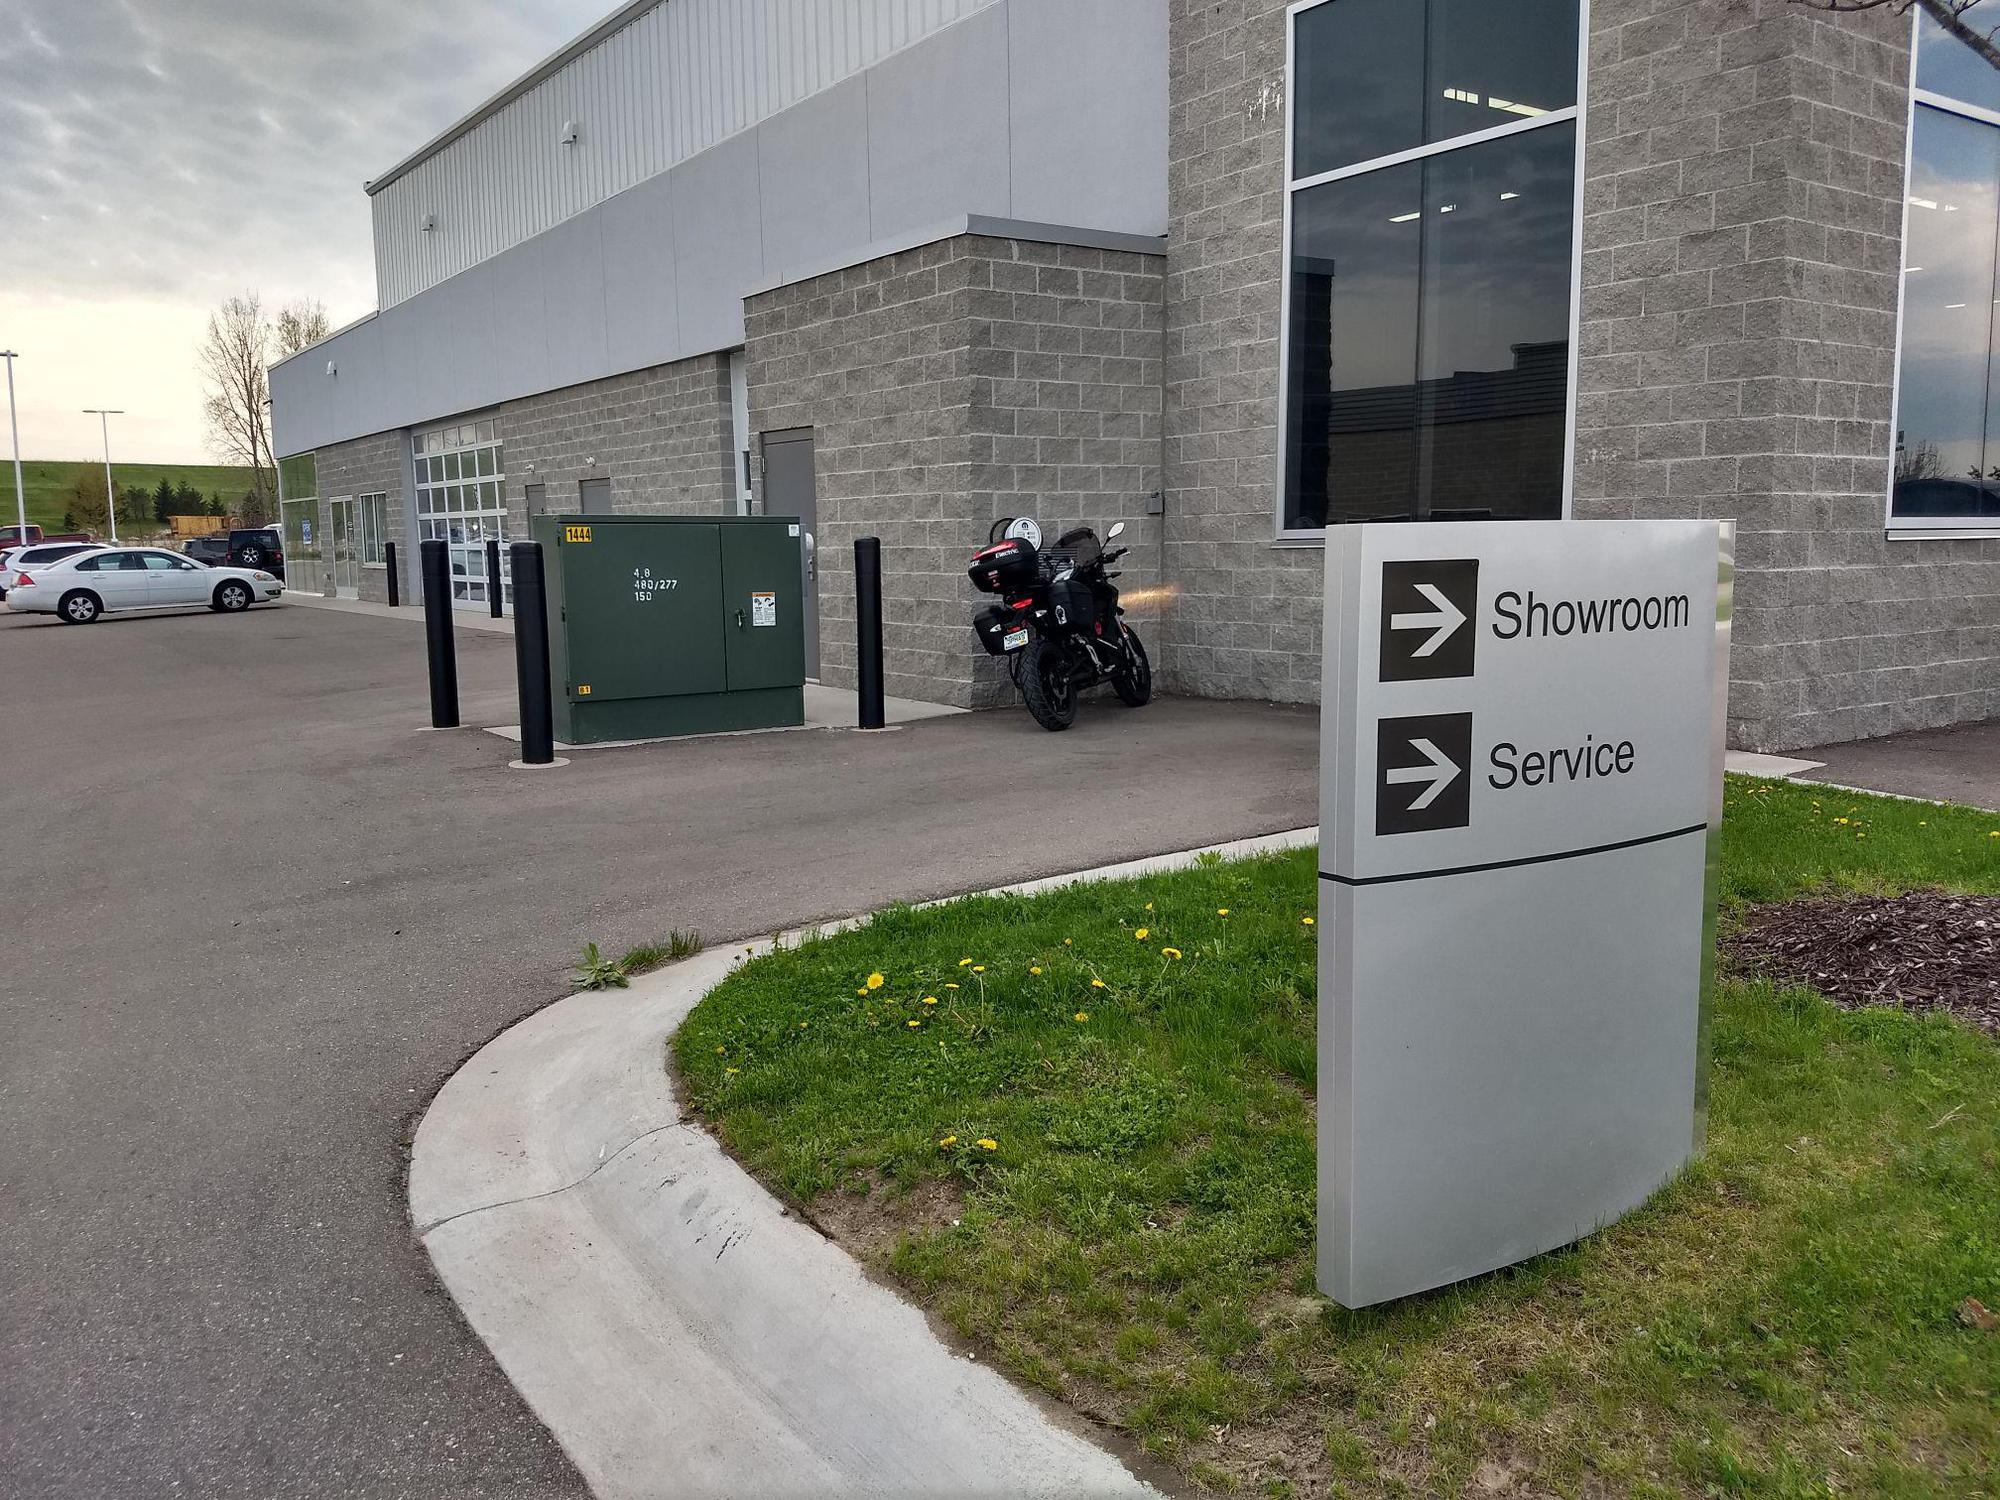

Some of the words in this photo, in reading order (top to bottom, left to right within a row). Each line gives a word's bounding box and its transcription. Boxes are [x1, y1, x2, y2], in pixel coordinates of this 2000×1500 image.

[567, 528, 591, 541] 1444
[634, 579, 678, 591] 480/277
[634, 591, 652, 602] 150
[1491, 590, 1690, 640] Showroom
[1487, 734, 1635, 790] Service
